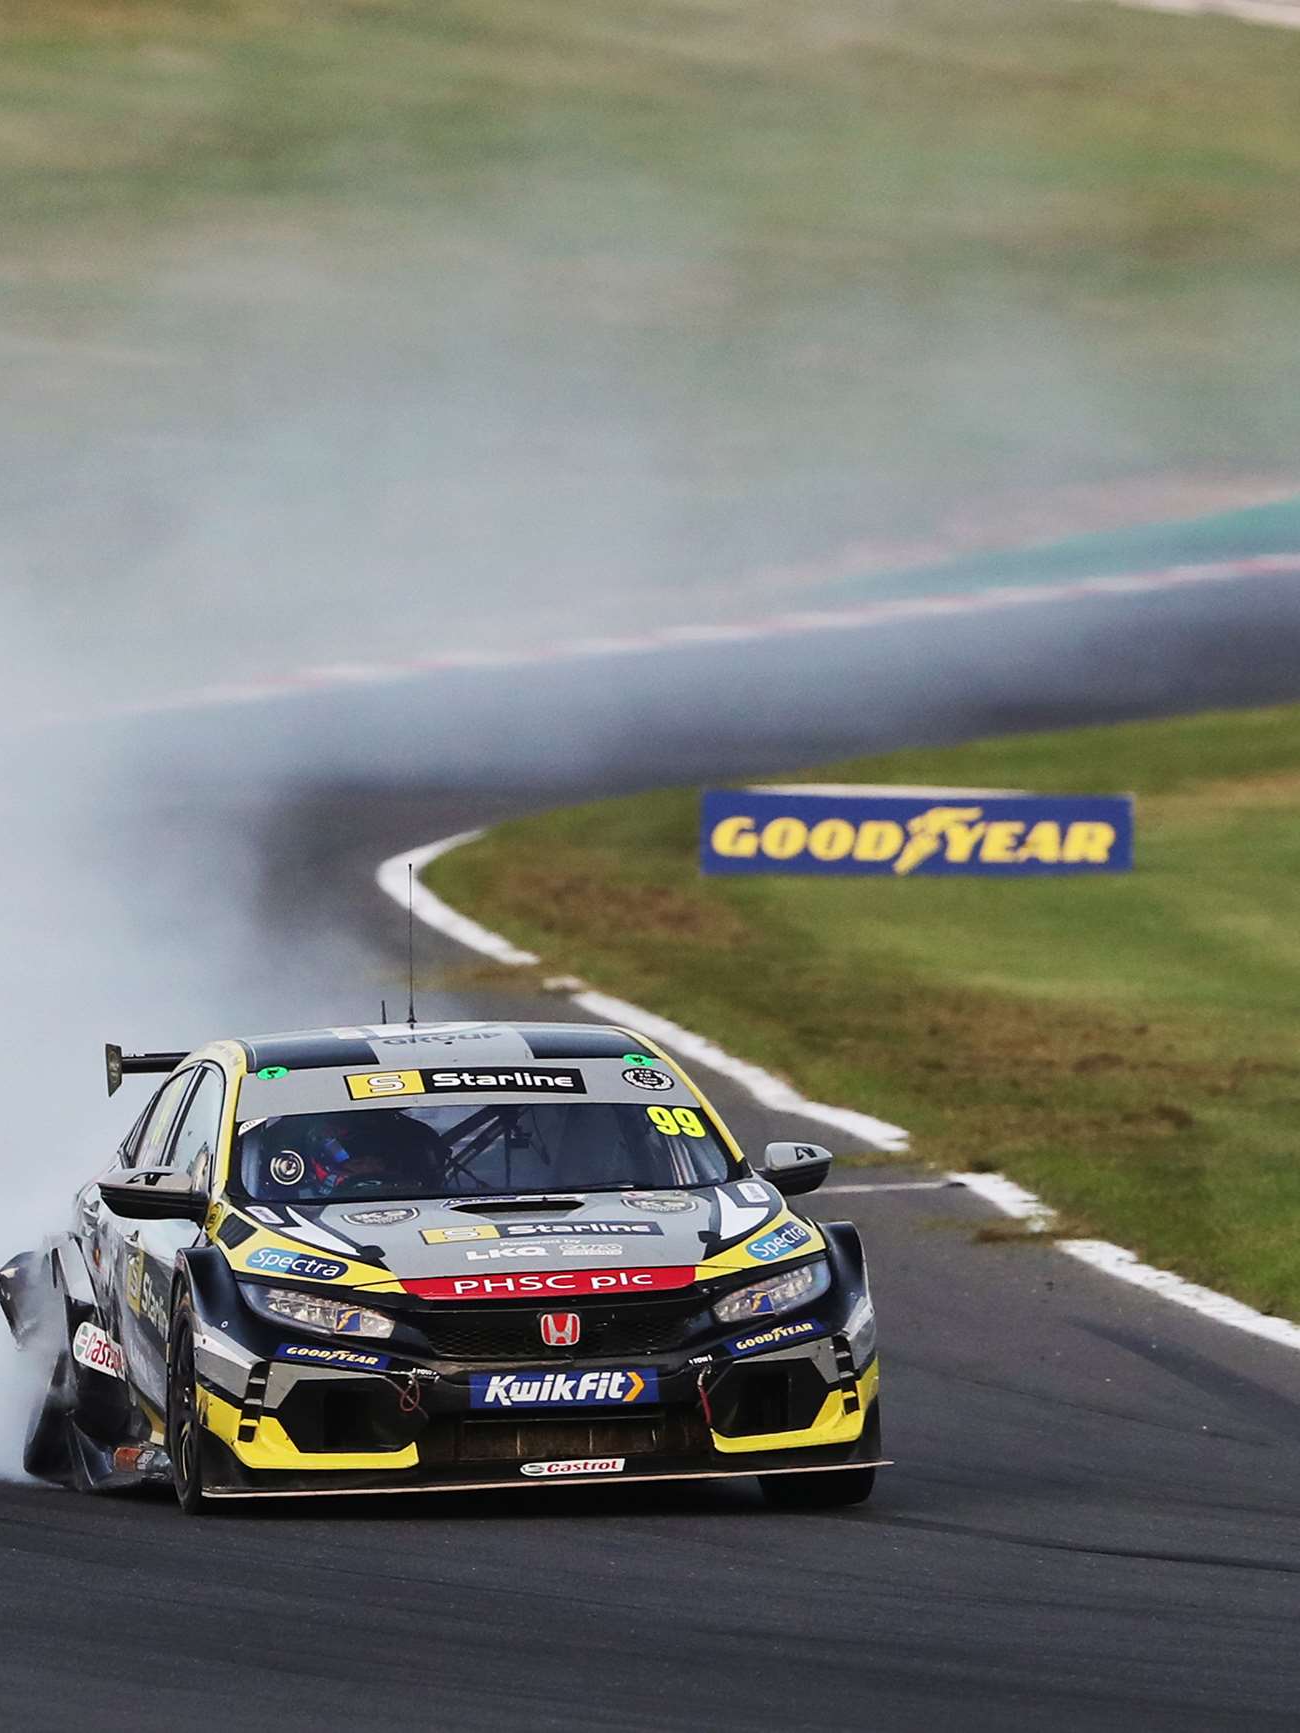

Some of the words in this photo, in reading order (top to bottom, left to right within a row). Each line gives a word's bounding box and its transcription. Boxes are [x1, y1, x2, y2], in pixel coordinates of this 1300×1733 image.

[711, 810, 1116, 871] GOODYEAR
[432, 1072, 575, 1088] Starline
[646, 1106, 707, 1138] 99
[507, 1221, 651, 1236] Starline
[750, 1224, 807, 1256] Spectra
[251, 1249, 340, 1278] Spectra
[466, 1246, 549, 1262] LKQ
[453, 1274, 576, 1295] PHSC
[590, 1272, 653, 1290] plc
[735, 1322, 813, 1350] GOODYEAR
[285, 1347, 380, 1366] GOODYEAR
[546, 1460, 619, 1473] Castrol
